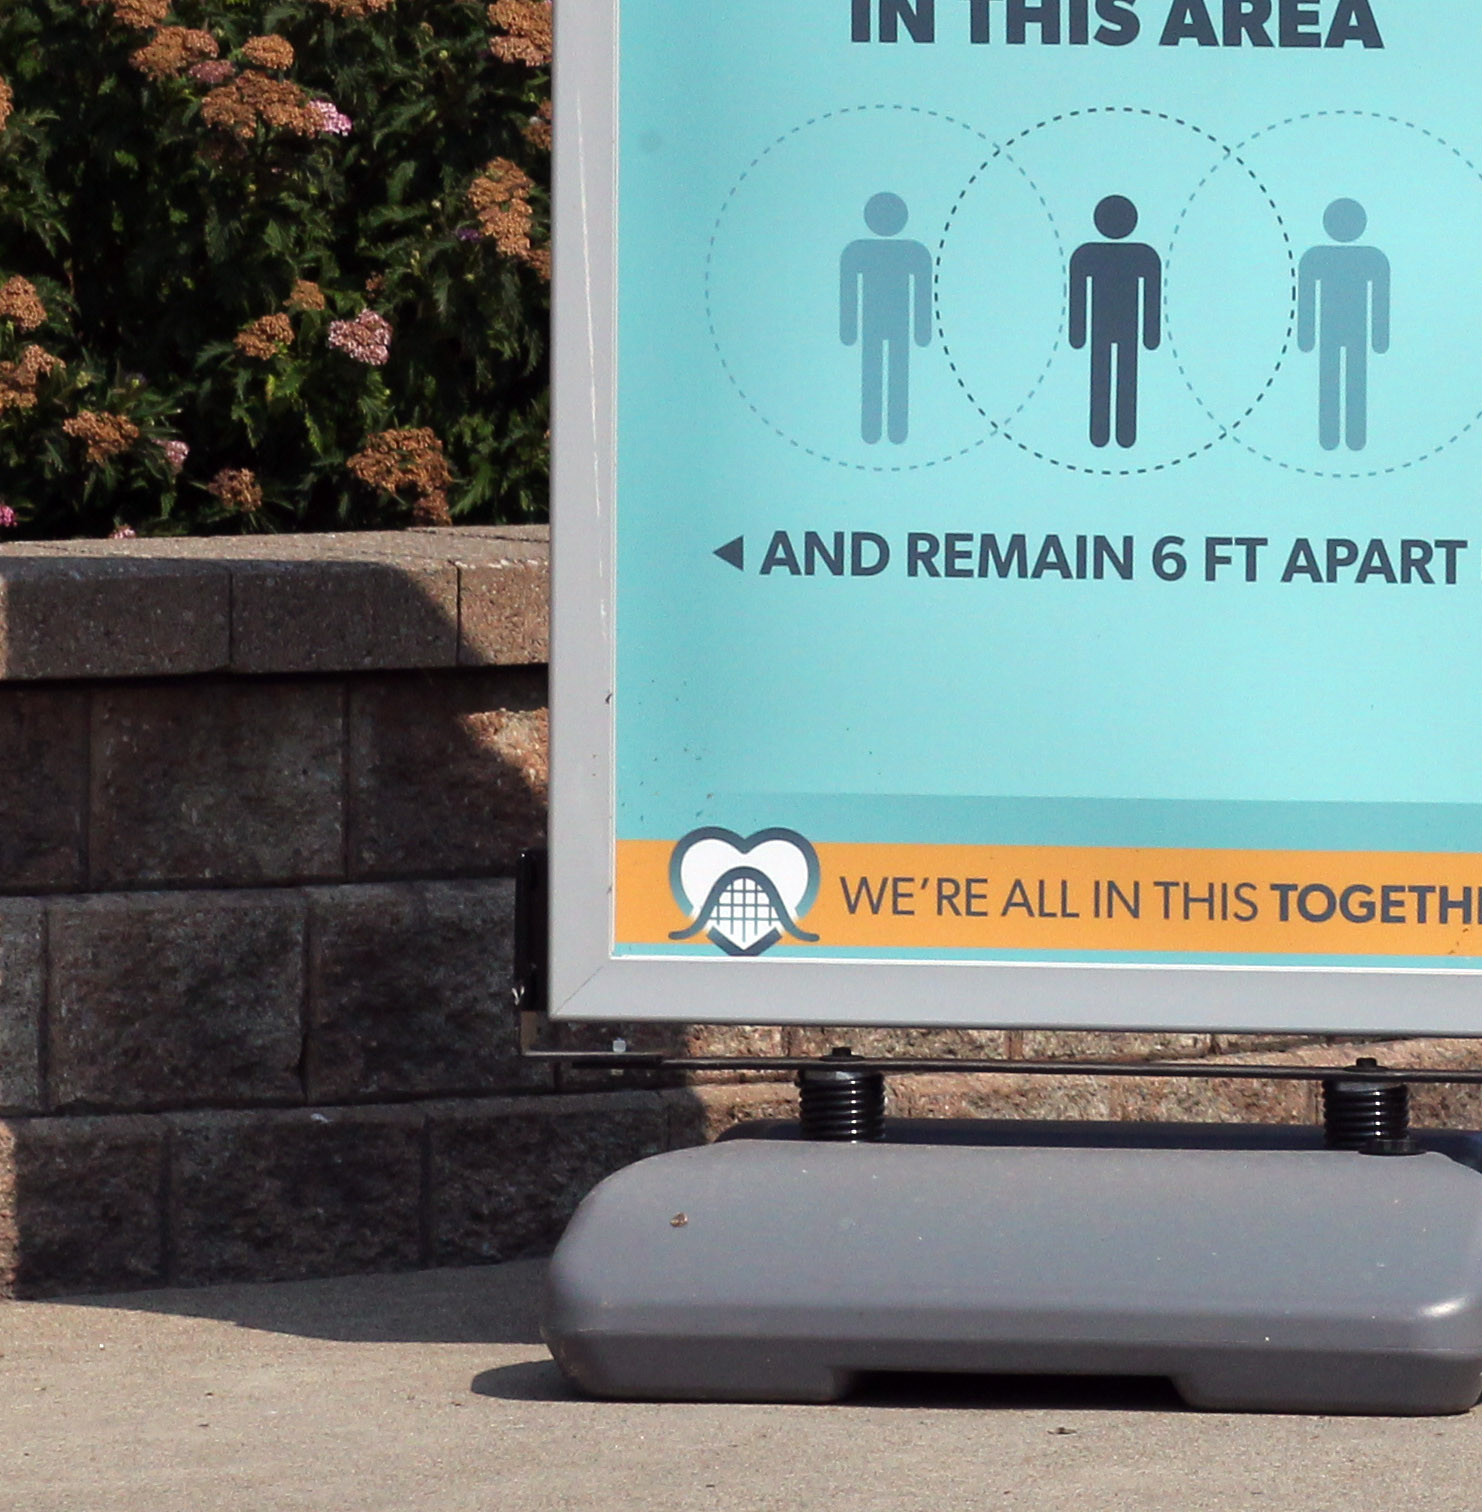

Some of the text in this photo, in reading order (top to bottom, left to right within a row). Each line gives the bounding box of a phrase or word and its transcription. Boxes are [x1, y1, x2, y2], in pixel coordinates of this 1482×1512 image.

[759, 530, 1468, 585] AND REMAIN 6 FT APART
[840, 876, 988, 917] WE'RE
[1001, 879, 1080, 918] ALL
[1094, 880, 1140, 919] IN
[1153, 881, 1258, 922] THIS
